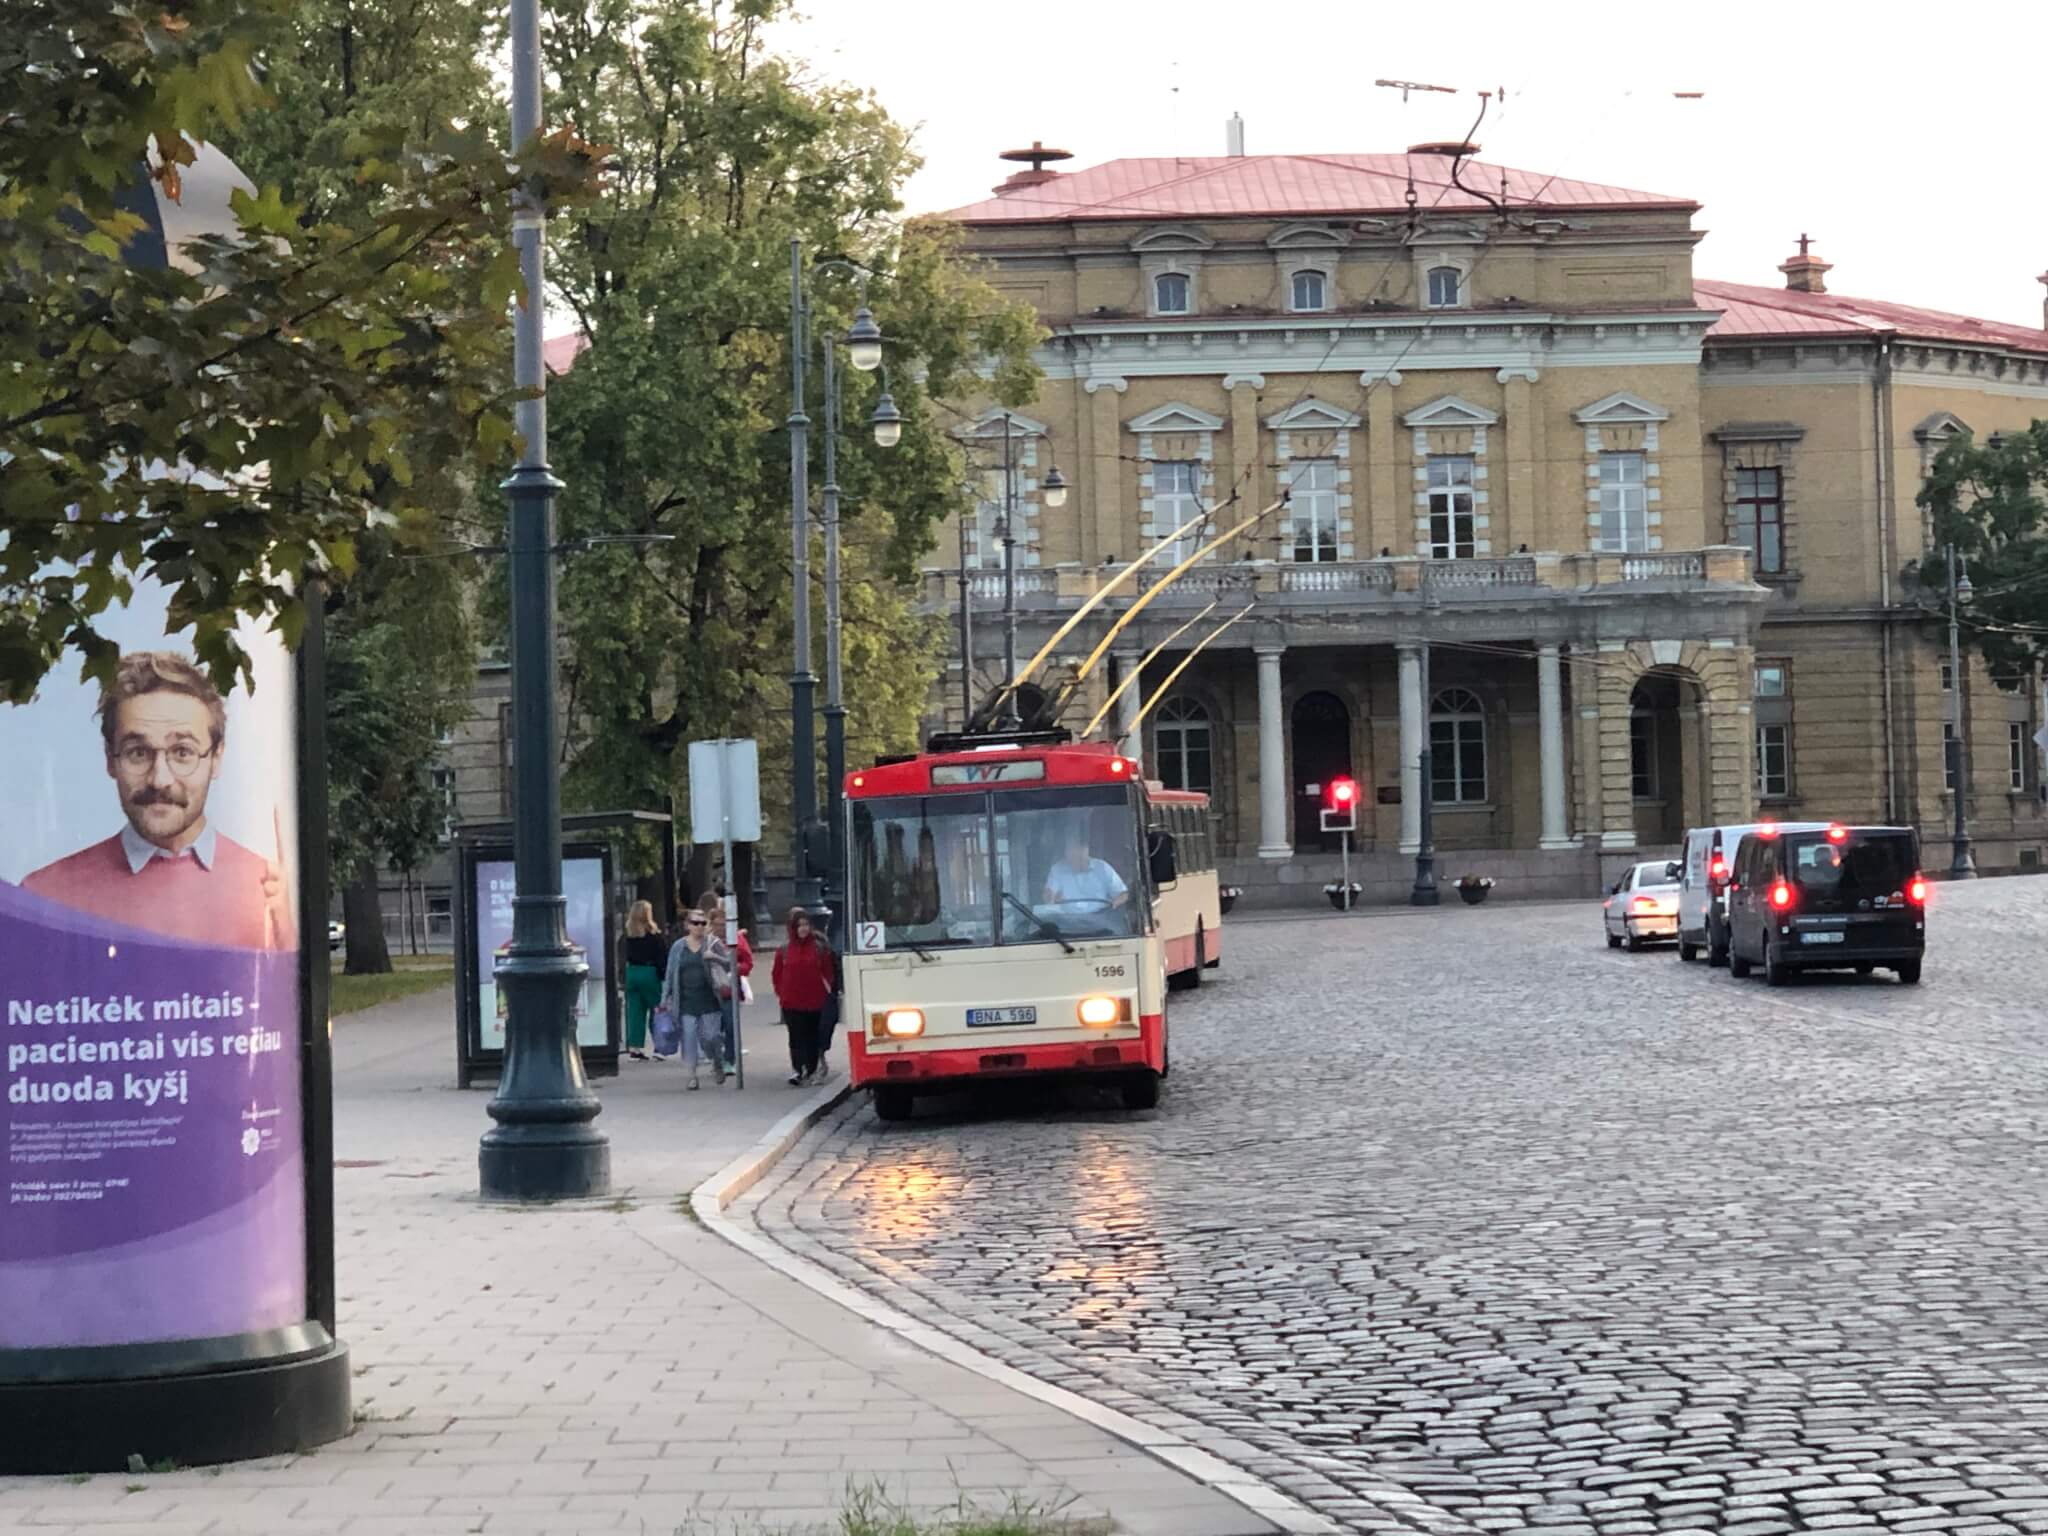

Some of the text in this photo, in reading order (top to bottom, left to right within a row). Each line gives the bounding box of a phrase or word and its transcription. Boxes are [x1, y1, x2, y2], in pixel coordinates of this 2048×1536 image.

[966, 764, 1009, 781] VVT
[864, 924, 878, 949] 2
[1094, 966, 1125, 977] 1596
[8, 995, 144, 1025] Netikėk
[153, 990, 243, 1020] mitais
[975, 1008, 1033, 1023] BNA 596
[8, 1026, 281, 1072] pacientai vis rečiau
[8, 1070, 188, 1106] duoda kyšį
